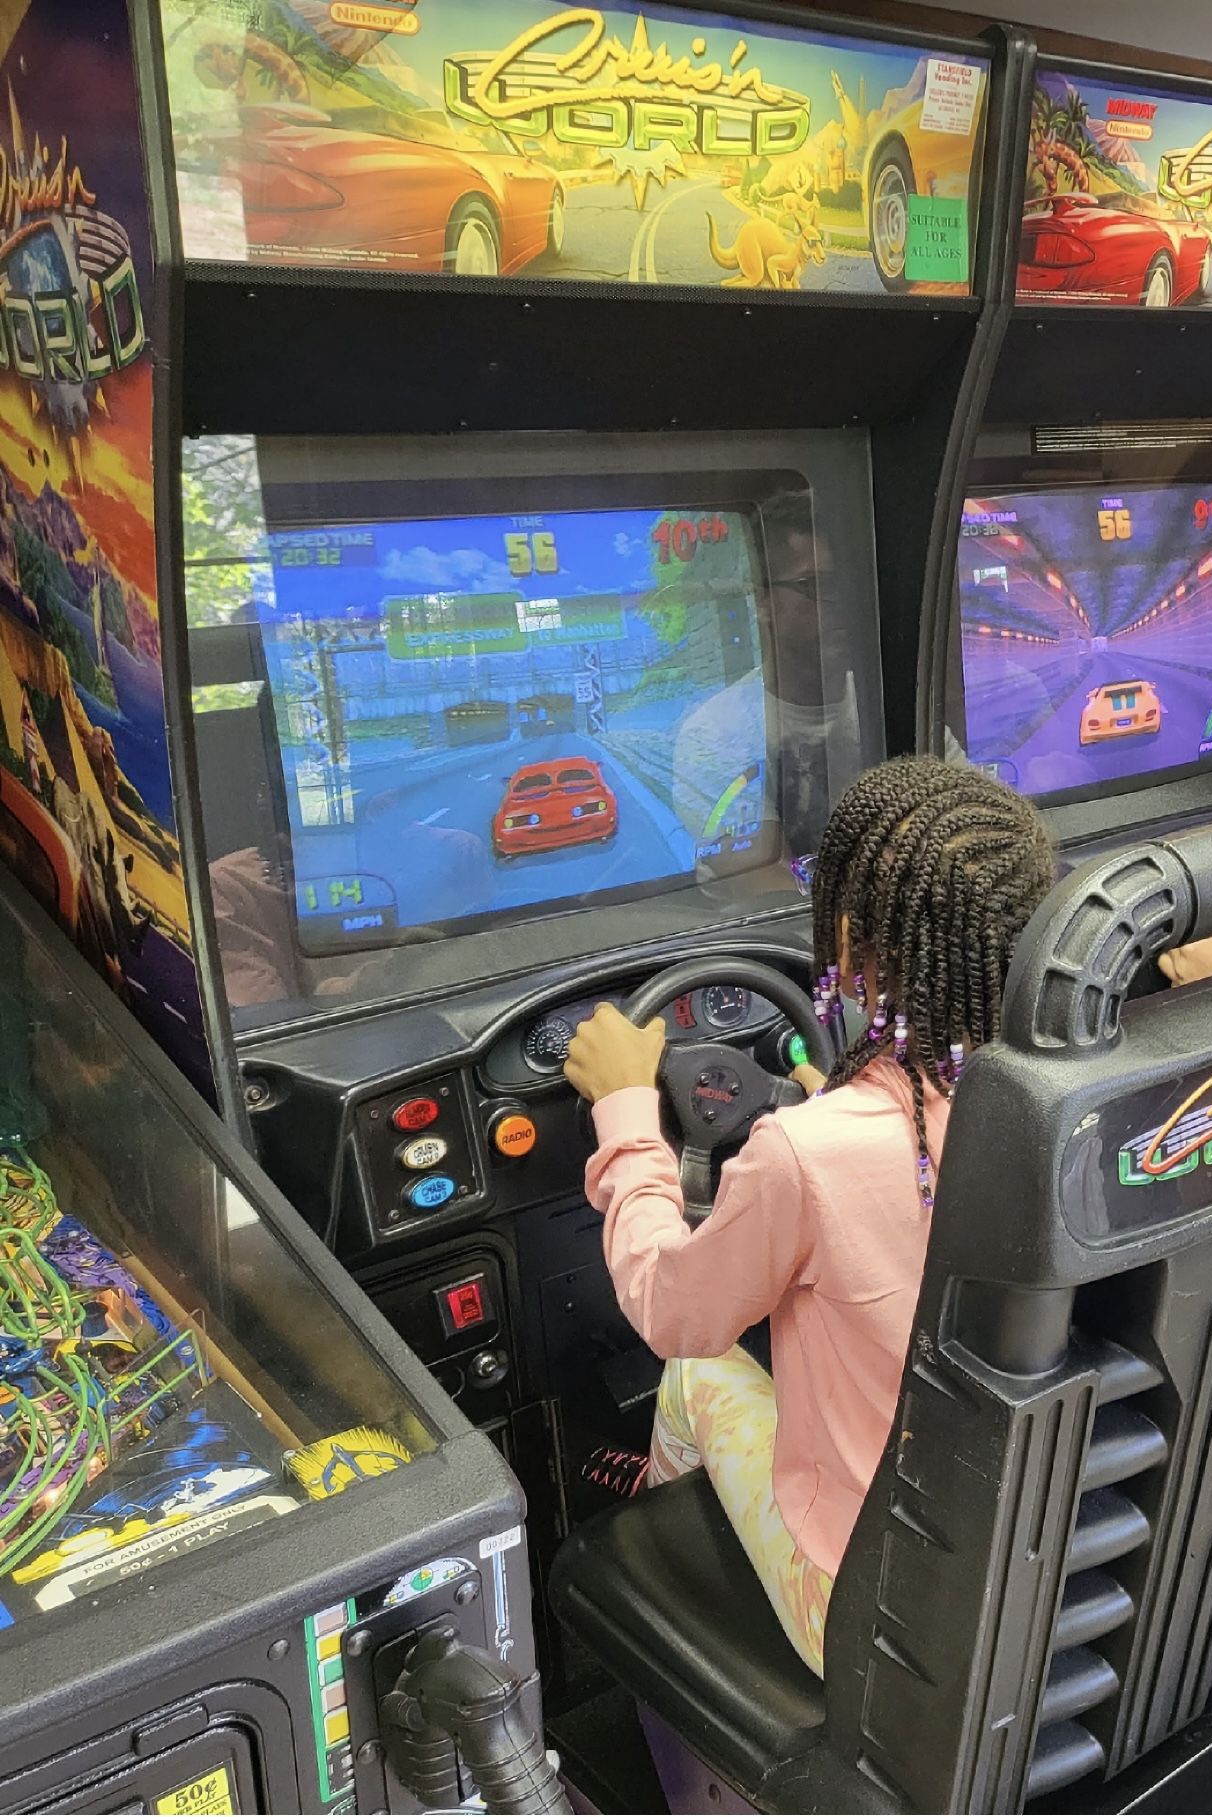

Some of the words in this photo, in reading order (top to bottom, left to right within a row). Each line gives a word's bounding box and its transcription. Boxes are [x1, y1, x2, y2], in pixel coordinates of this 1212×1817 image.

[443, 59, 811, 156] WORLD
[1106, 97, 1158, 119] MIDWAY
[911, 214, 961, 228] SUITABLE
[926, 231, 947, 243] FOR
[911, 246, 932, 258] ALL
[935, 247, 962, 259] AGES
[0, 254, 145, 383] ORLD
[511, 516, 545, 529] TIME
[1098, 509, 1132, 541] 56
[332, 532, 374, 546] TIME
[504, 532, 559, 577] 56
[406, 628, 514, 647] EXPRESSWAY
[342, 914, 383, 931] MPH
[502, 1128, 533, 1145] RADIO
[421, 1180, 447, 1198] CHASE
[82, 1557, 116, 1576] FOR
[119, 1517, 208, 1562] AMUSEMENT
[211, 1503, 248, 1523] ONLY
[183, 1521, 230, 1548] PLAY
[174, 1777, 218, 1809] 50¢
